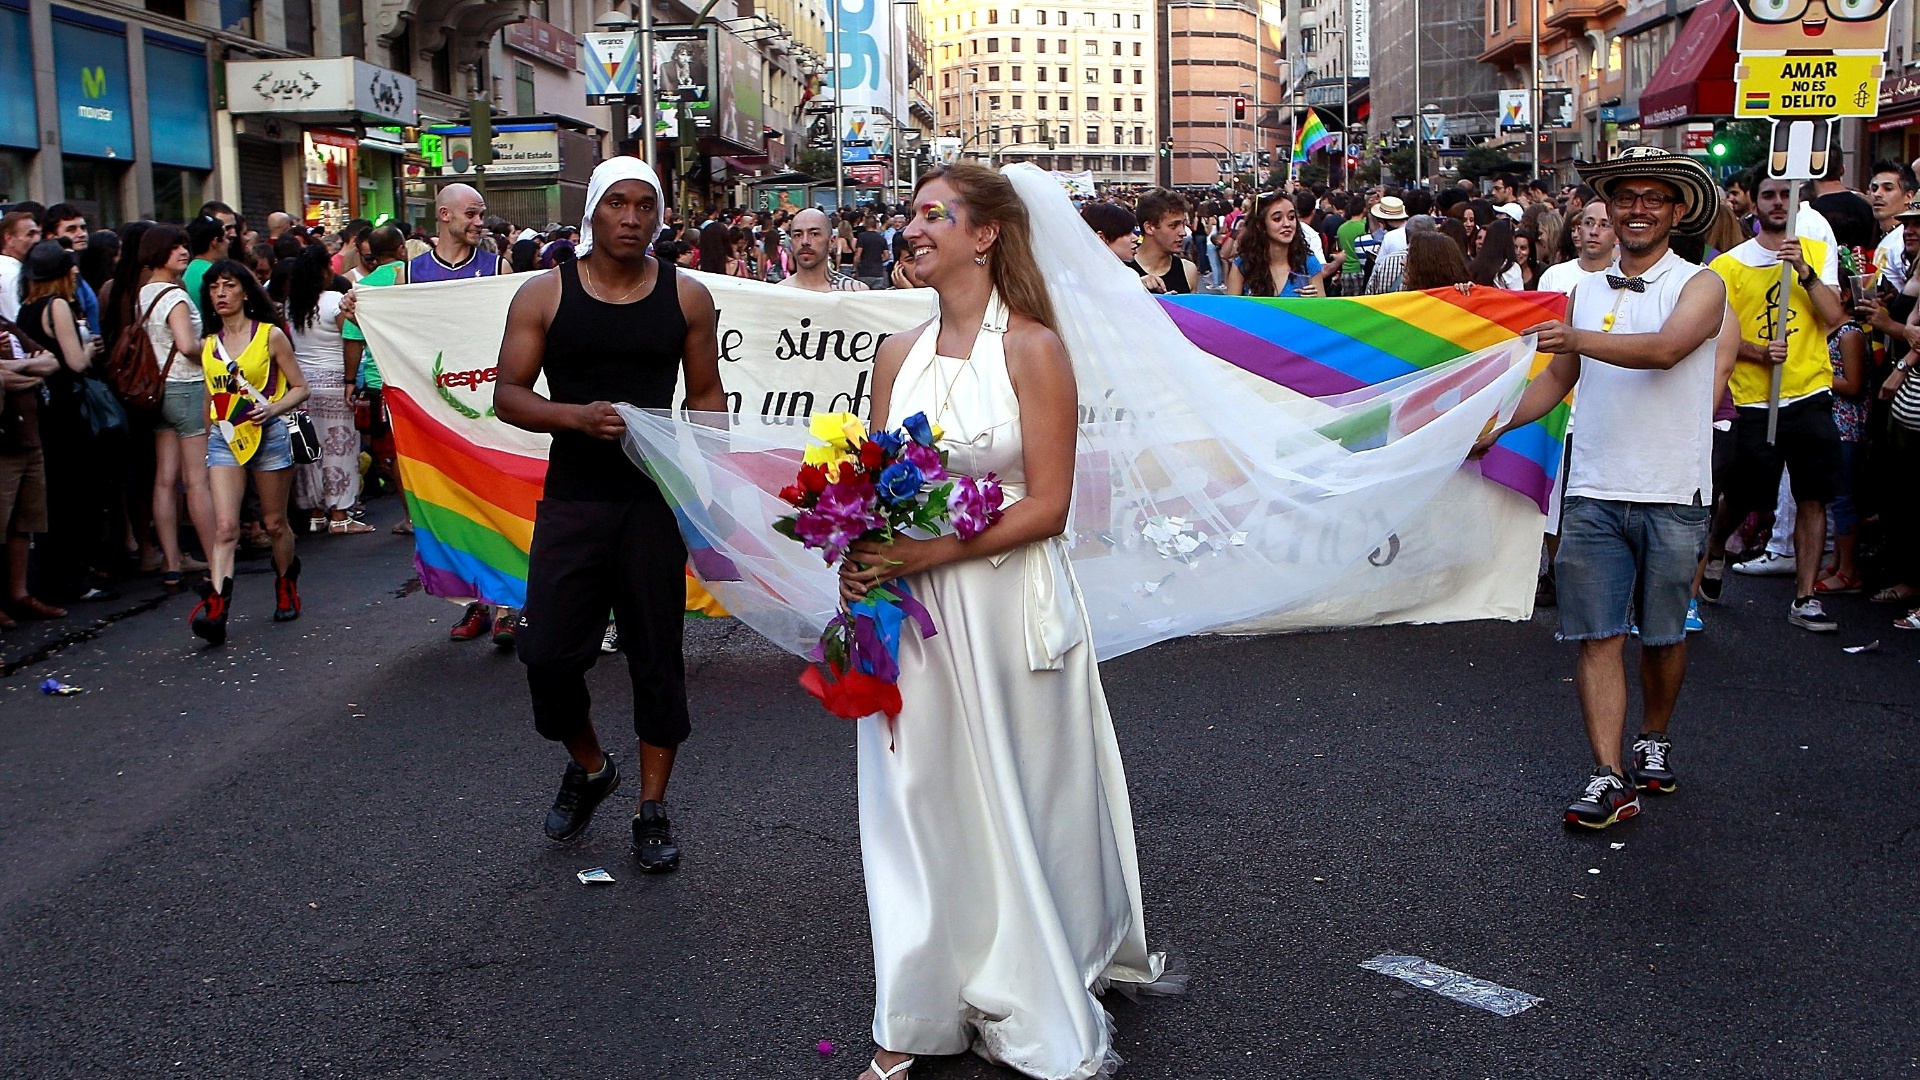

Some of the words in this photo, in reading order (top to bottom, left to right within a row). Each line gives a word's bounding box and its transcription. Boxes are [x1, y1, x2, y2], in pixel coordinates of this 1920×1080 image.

[1780, 61, 1837, 79] AMAR
[1791, 81, 1810, 92] NO
[1812, 81, 1826, 92] ES
[1781, 94, 1837, 108] DELITO
[514, 151, 526, 160] del
[527, 151, 553, 160] Estado
[436, 367, 498, 391] respe
[761, 391, 814, 427] un
